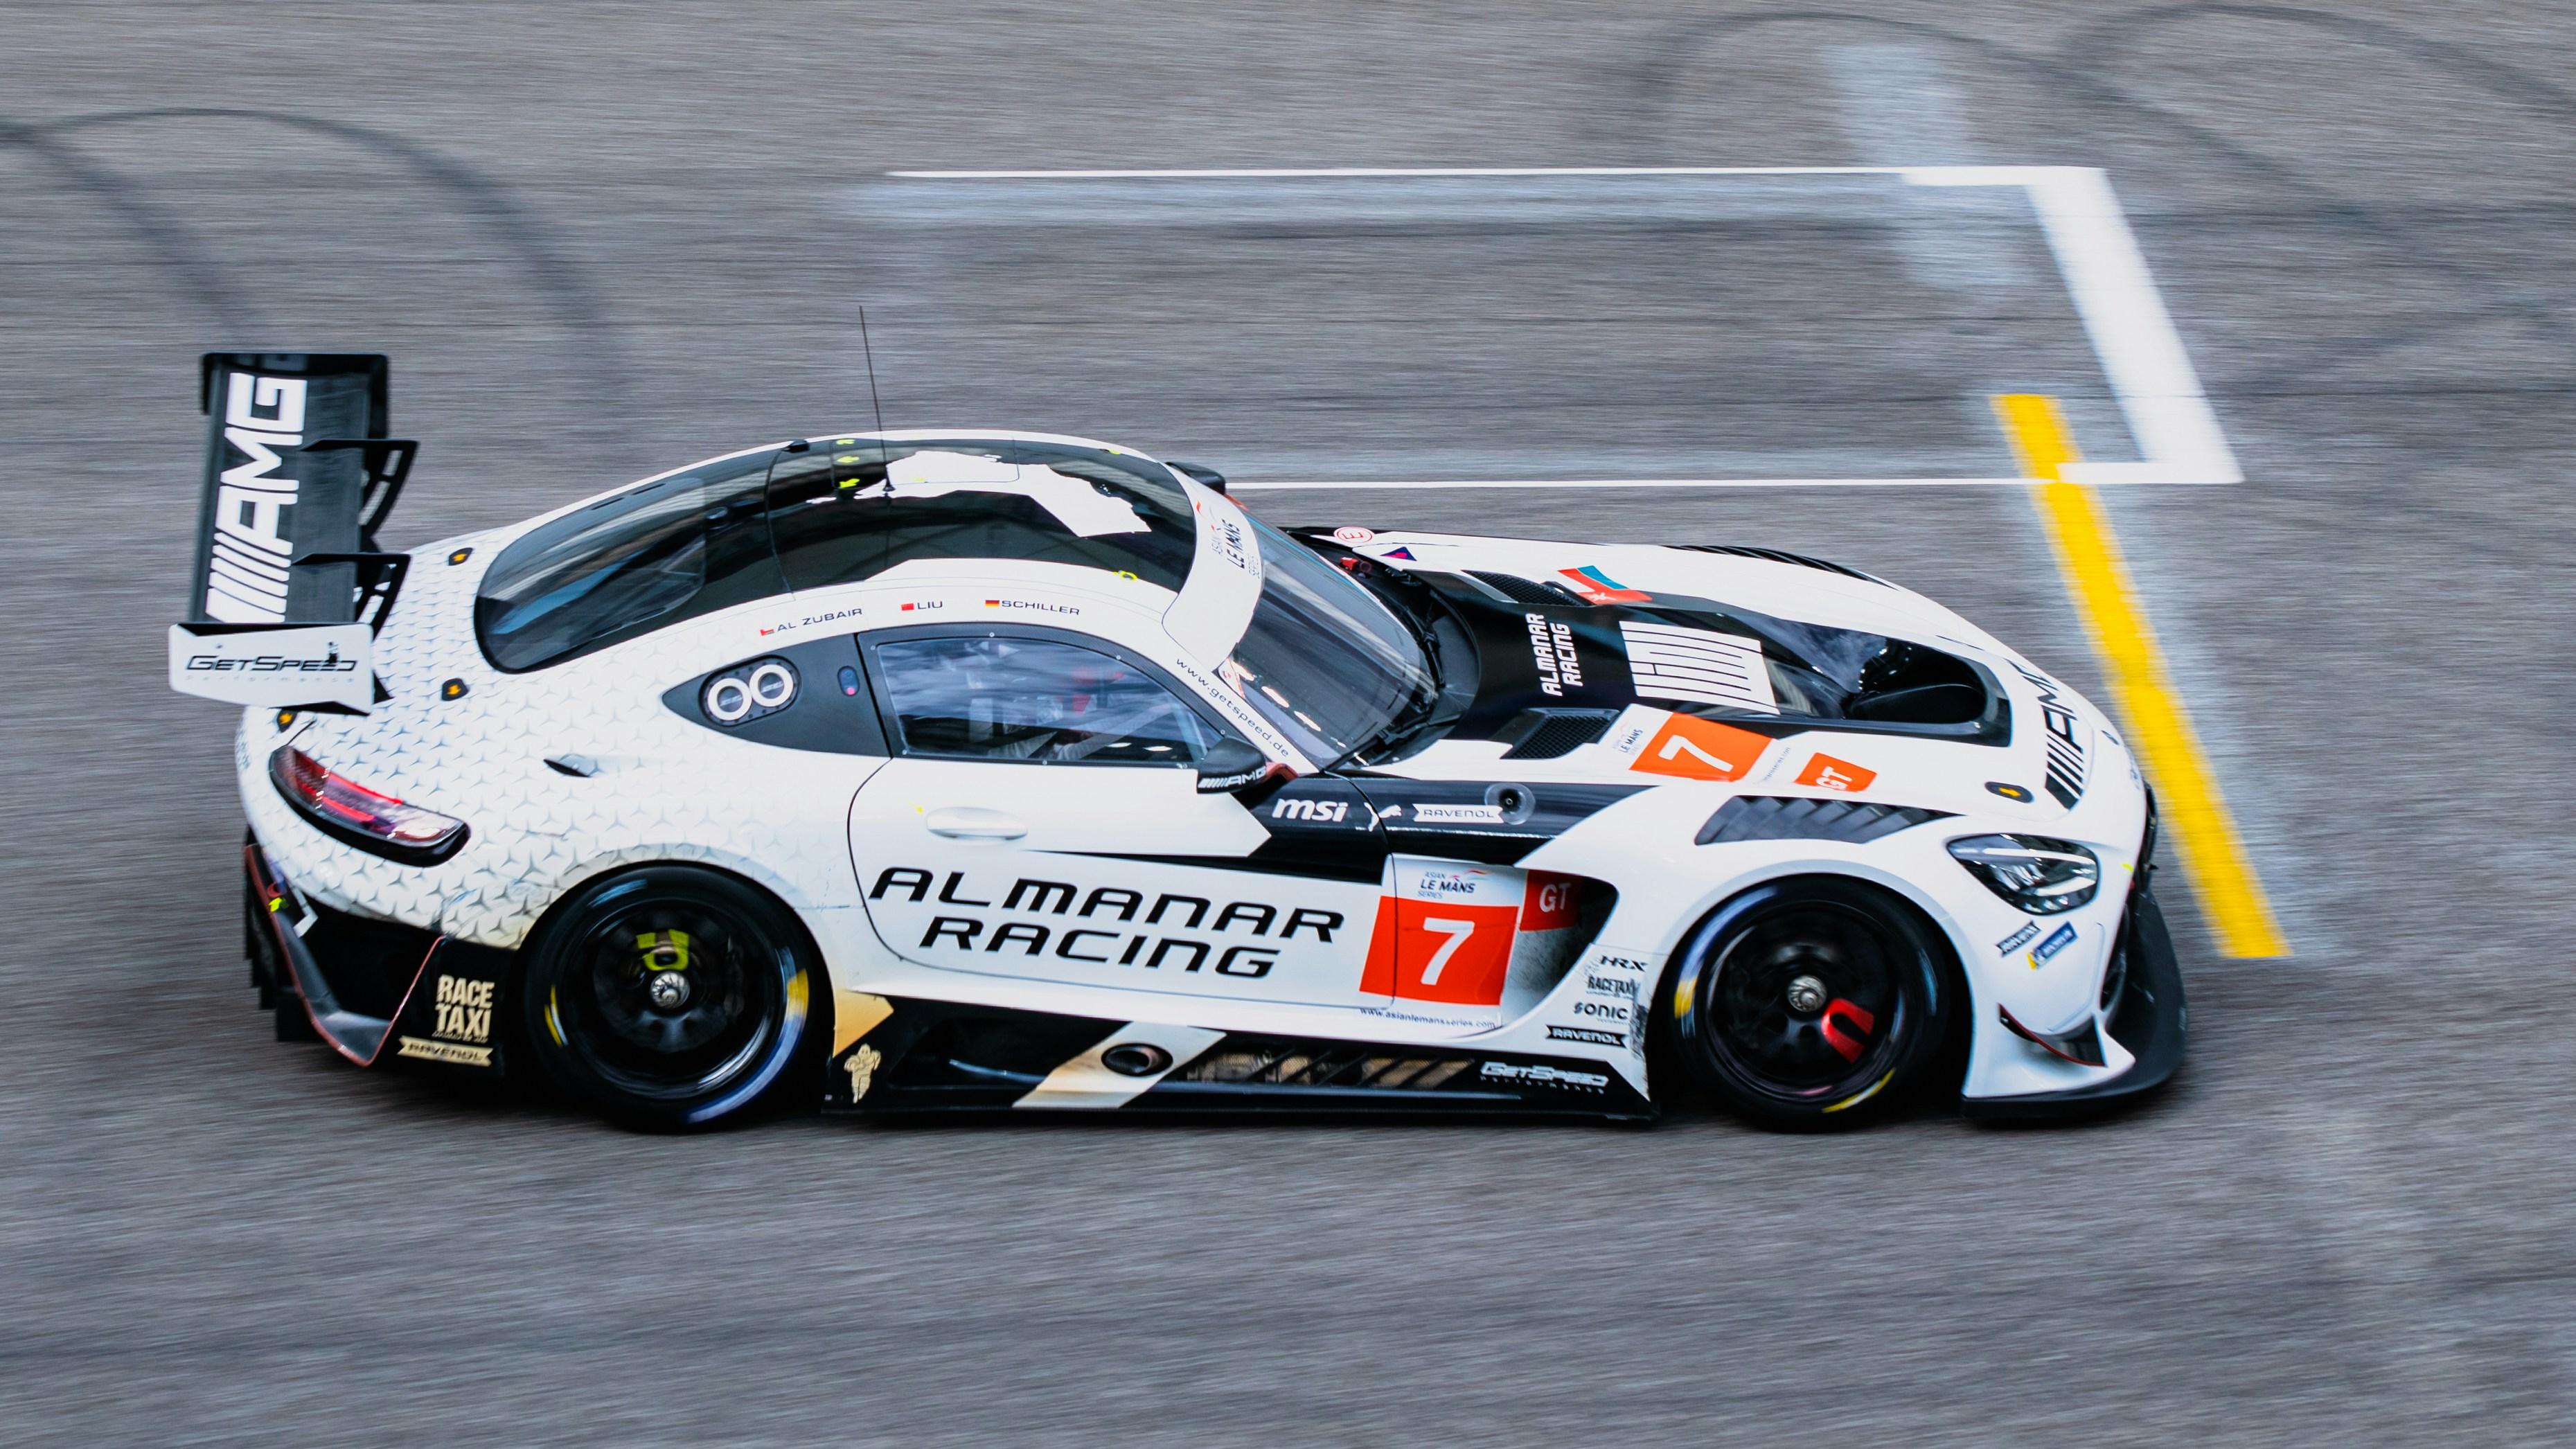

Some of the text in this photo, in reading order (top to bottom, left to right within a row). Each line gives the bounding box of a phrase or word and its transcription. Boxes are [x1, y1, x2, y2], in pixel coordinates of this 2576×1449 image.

[215, 373, 308, 555] AMG
[1226, 549, 1245, 569] LE
[776, 607, 863, 632] AL ZUBAIR
[917, 601, 943, 610] LIU
[1001, 600, 1081, 616] SCHILLER
[1525, 613, 1563, 697] ALMANAR
[1549, 623, 1583, 687] RACING
[1176, 659, 1289, 757] www.getspeed.de
[1658, 734, 1734, 773] 7
[1225, 765, 1267, 788] AMG
[1815, 766, 1853, 791] GT
[1272, 798, 1349, 823] msi
[1423, 809, 1495, 819] RAVENOL
[1420, 879, 1436, 890] LE
[1538, 882, 1572, 913] GT
[868, 866, 1345, 943] ALMANAR
[918, 915, 1281, 979] RACING
[1421, 916, 1475, 986] 7
[1599, 954, 1649, 972] HRX
[436, 974, 495, 1009] RACE
[435, 1002, 492, 1038] TAXI
